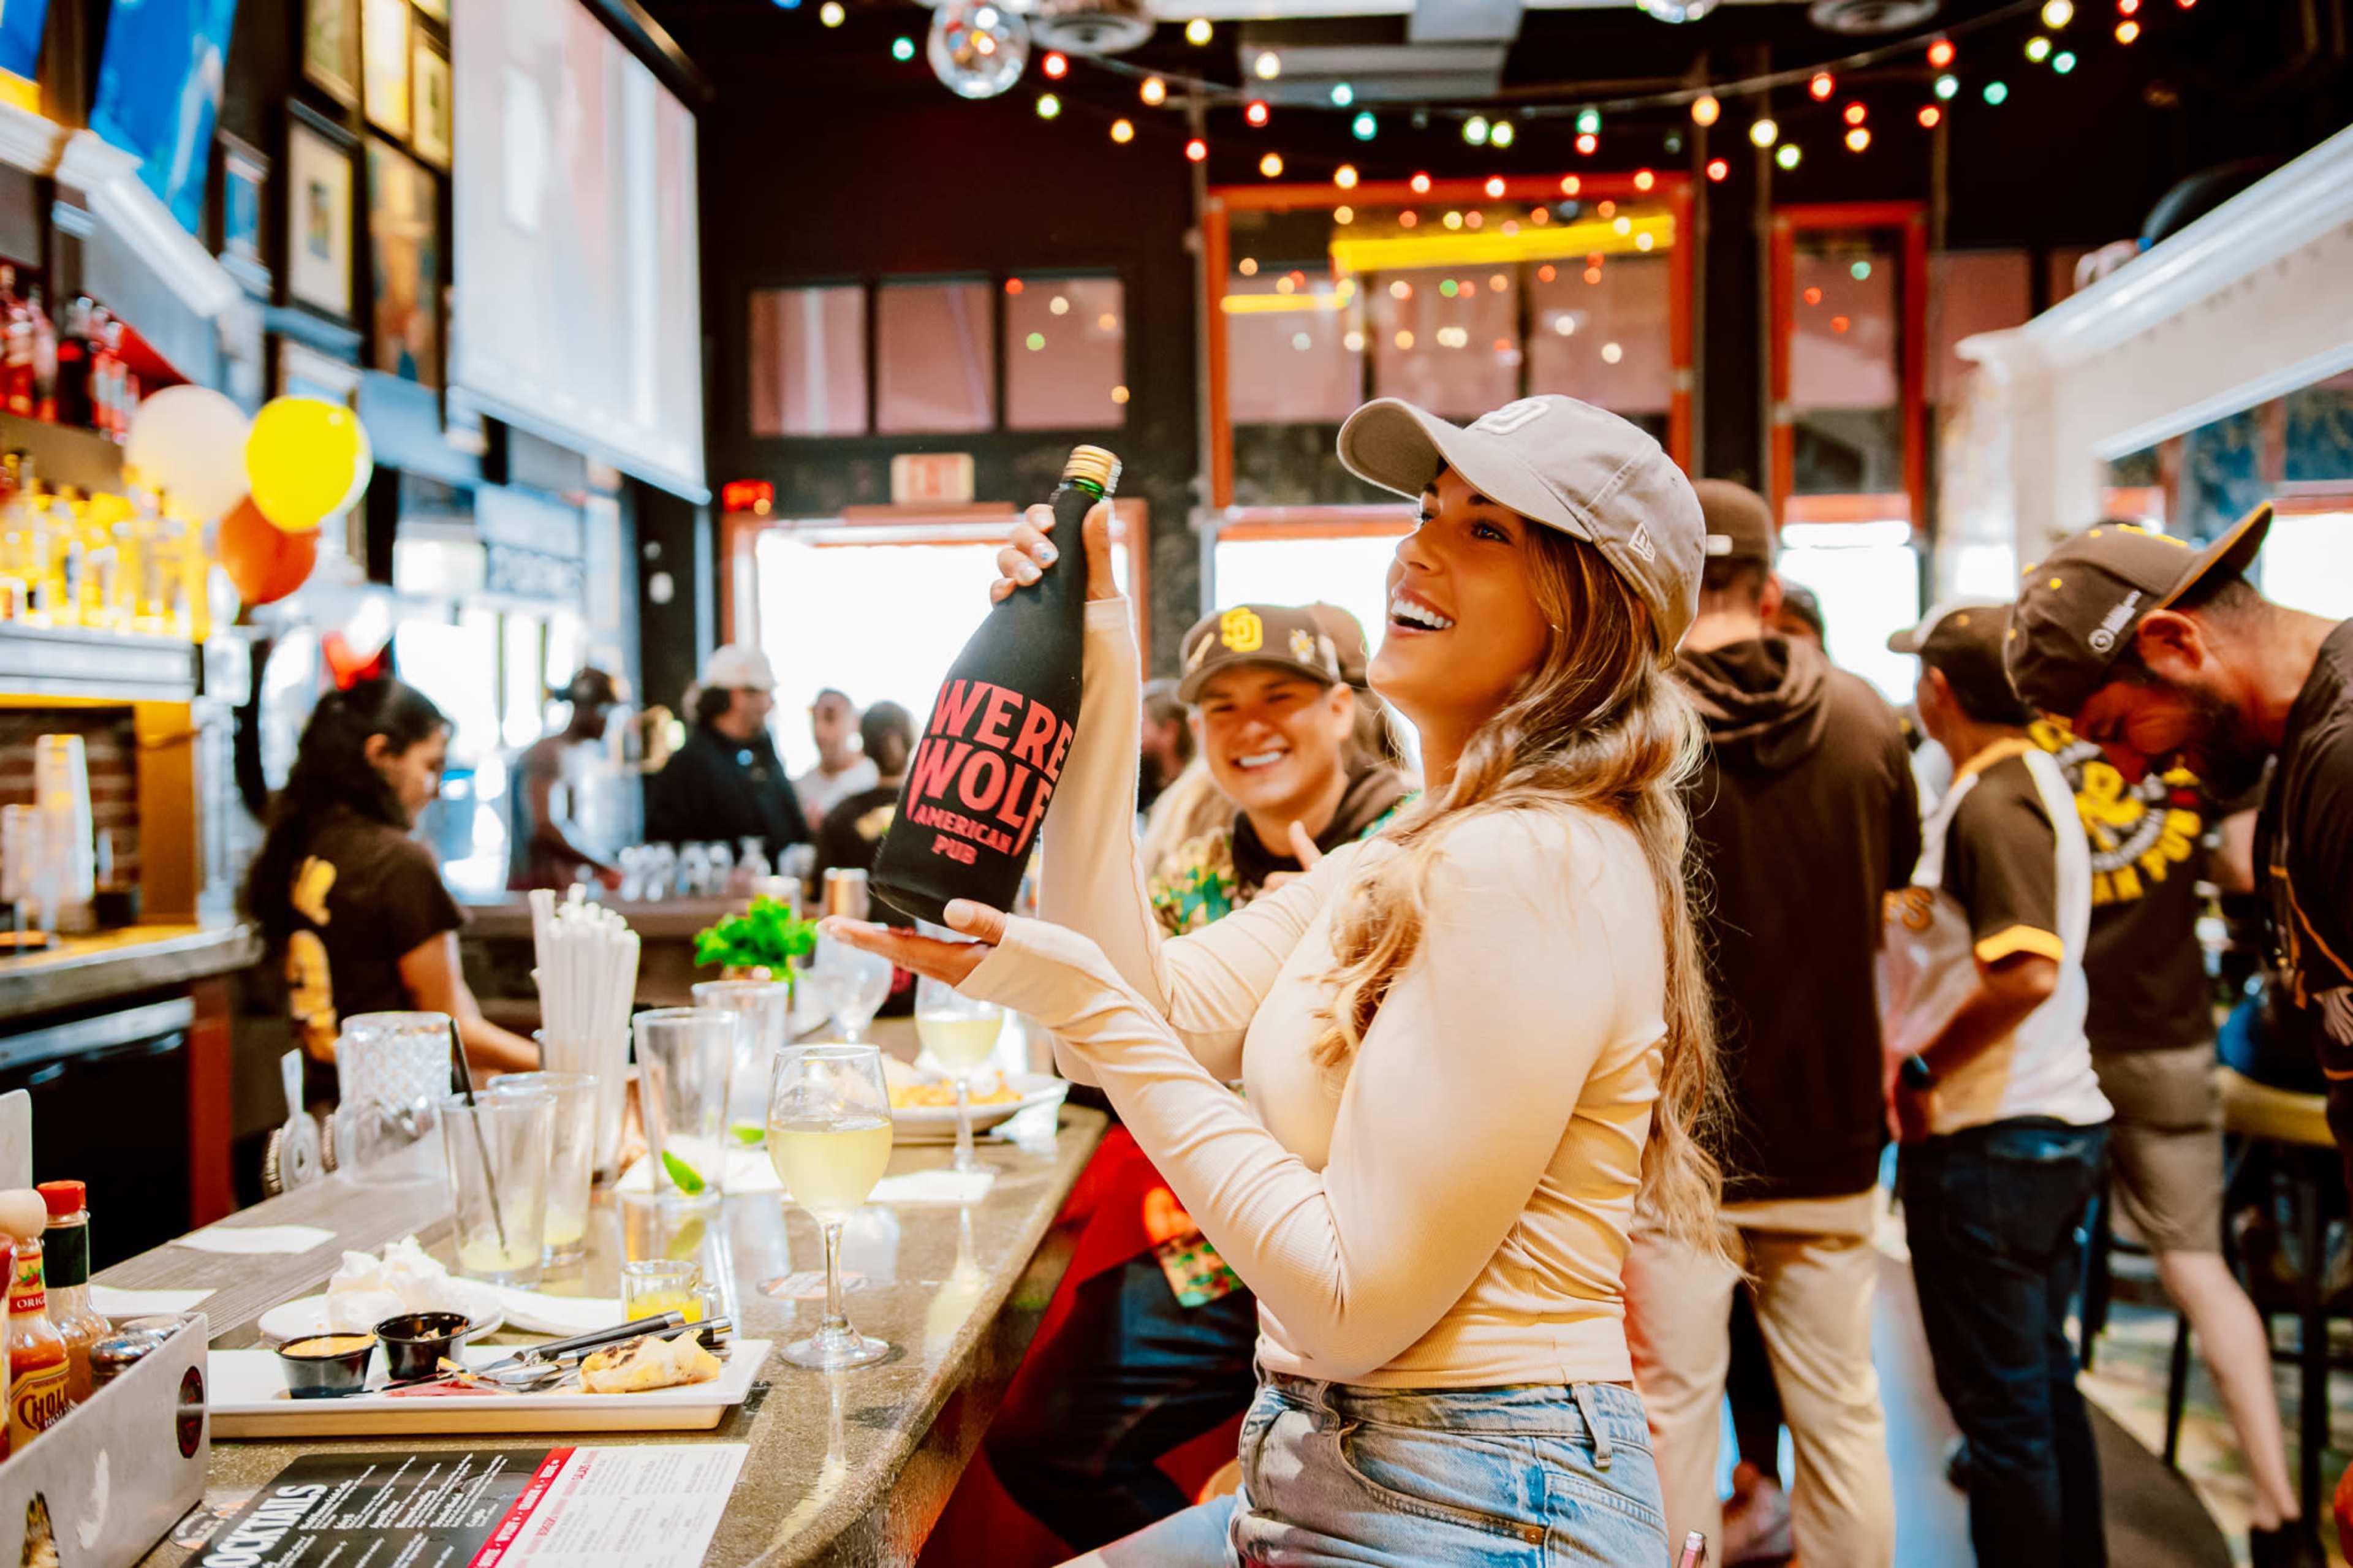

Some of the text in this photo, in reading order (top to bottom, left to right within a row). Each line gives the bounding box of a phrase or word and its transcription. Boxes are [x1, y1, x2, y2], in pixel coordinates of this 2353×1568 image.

[930, 678, 1074, 782] WERE
[906, 737, 1053, 858] WOLF
[913, 804, 1014, 855] AMERICAN
[931, 834, 979, 866] PUB
[202, 1483, 328, 1568] OCKTAILS
